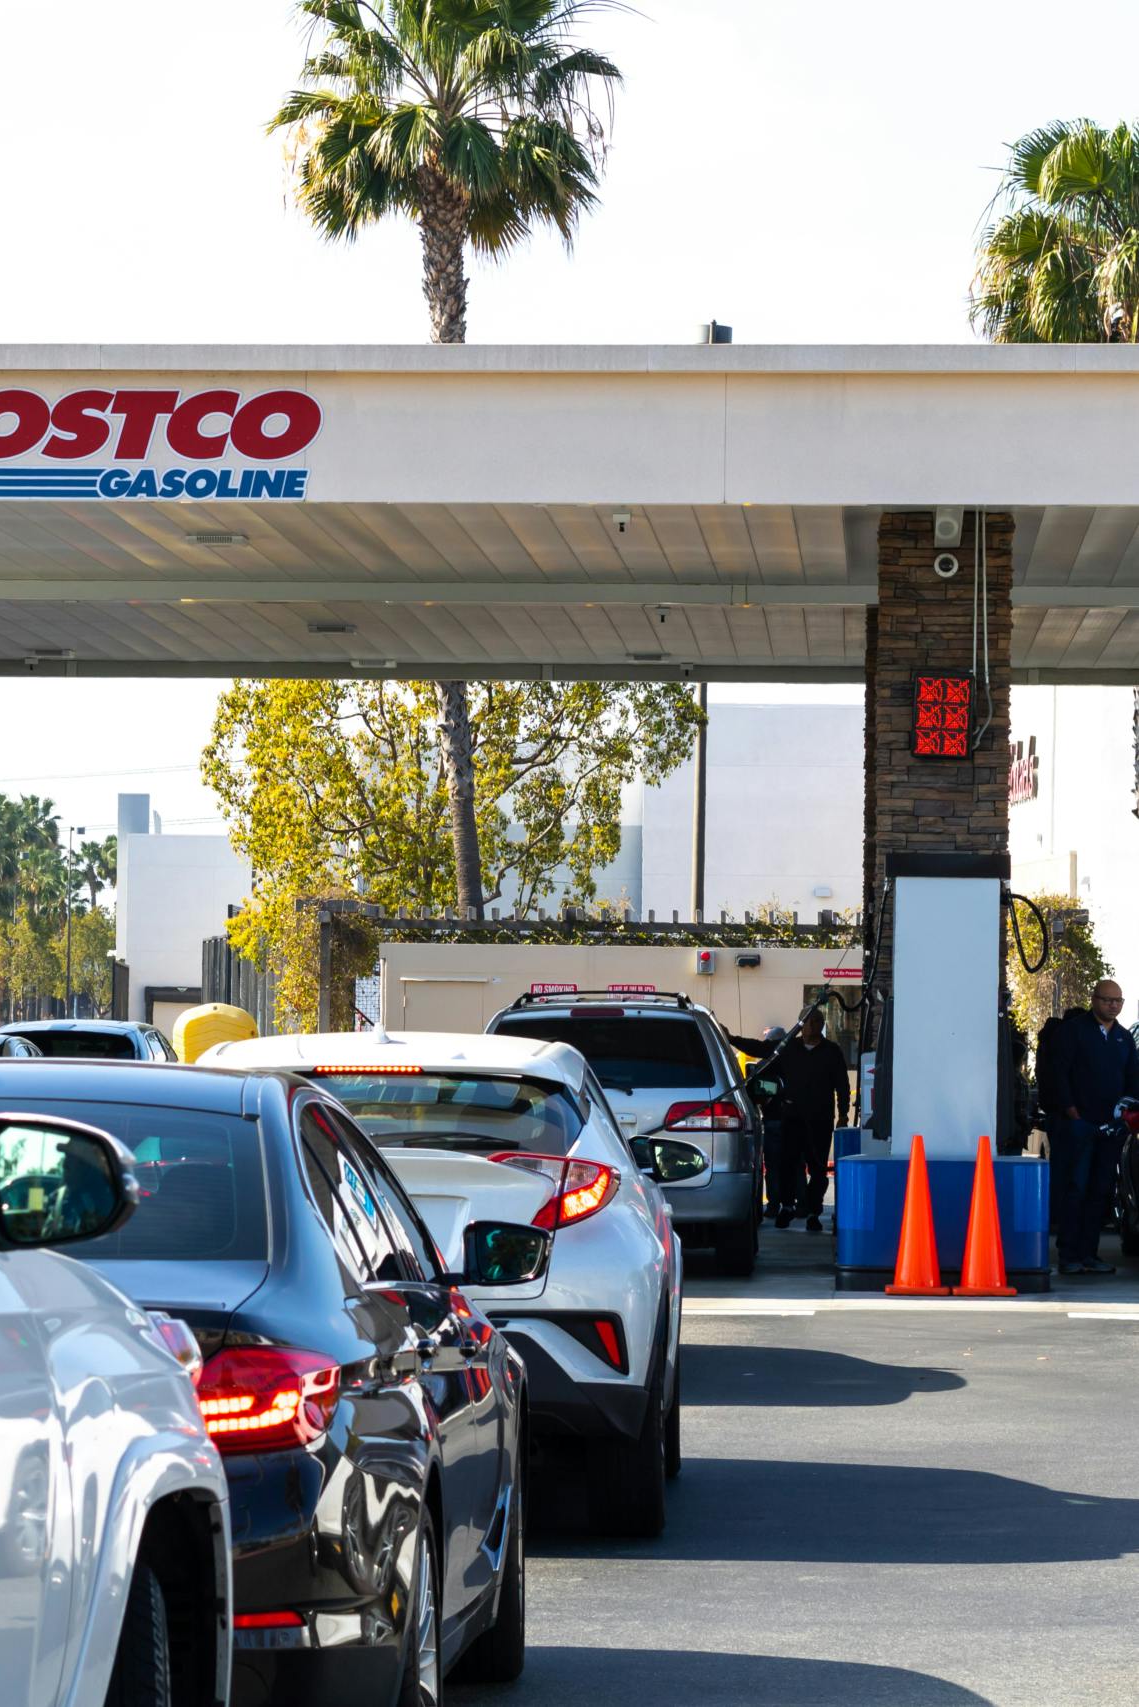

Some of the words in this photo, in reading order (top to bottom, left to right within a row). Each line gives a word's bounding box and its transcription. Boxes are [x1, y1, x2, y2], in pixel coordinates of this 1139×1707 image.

[99, 469, 308, 498] GASOLINE
[533, 985, 542, 993] NO
[544, 985, 574, 993] SMOKING
